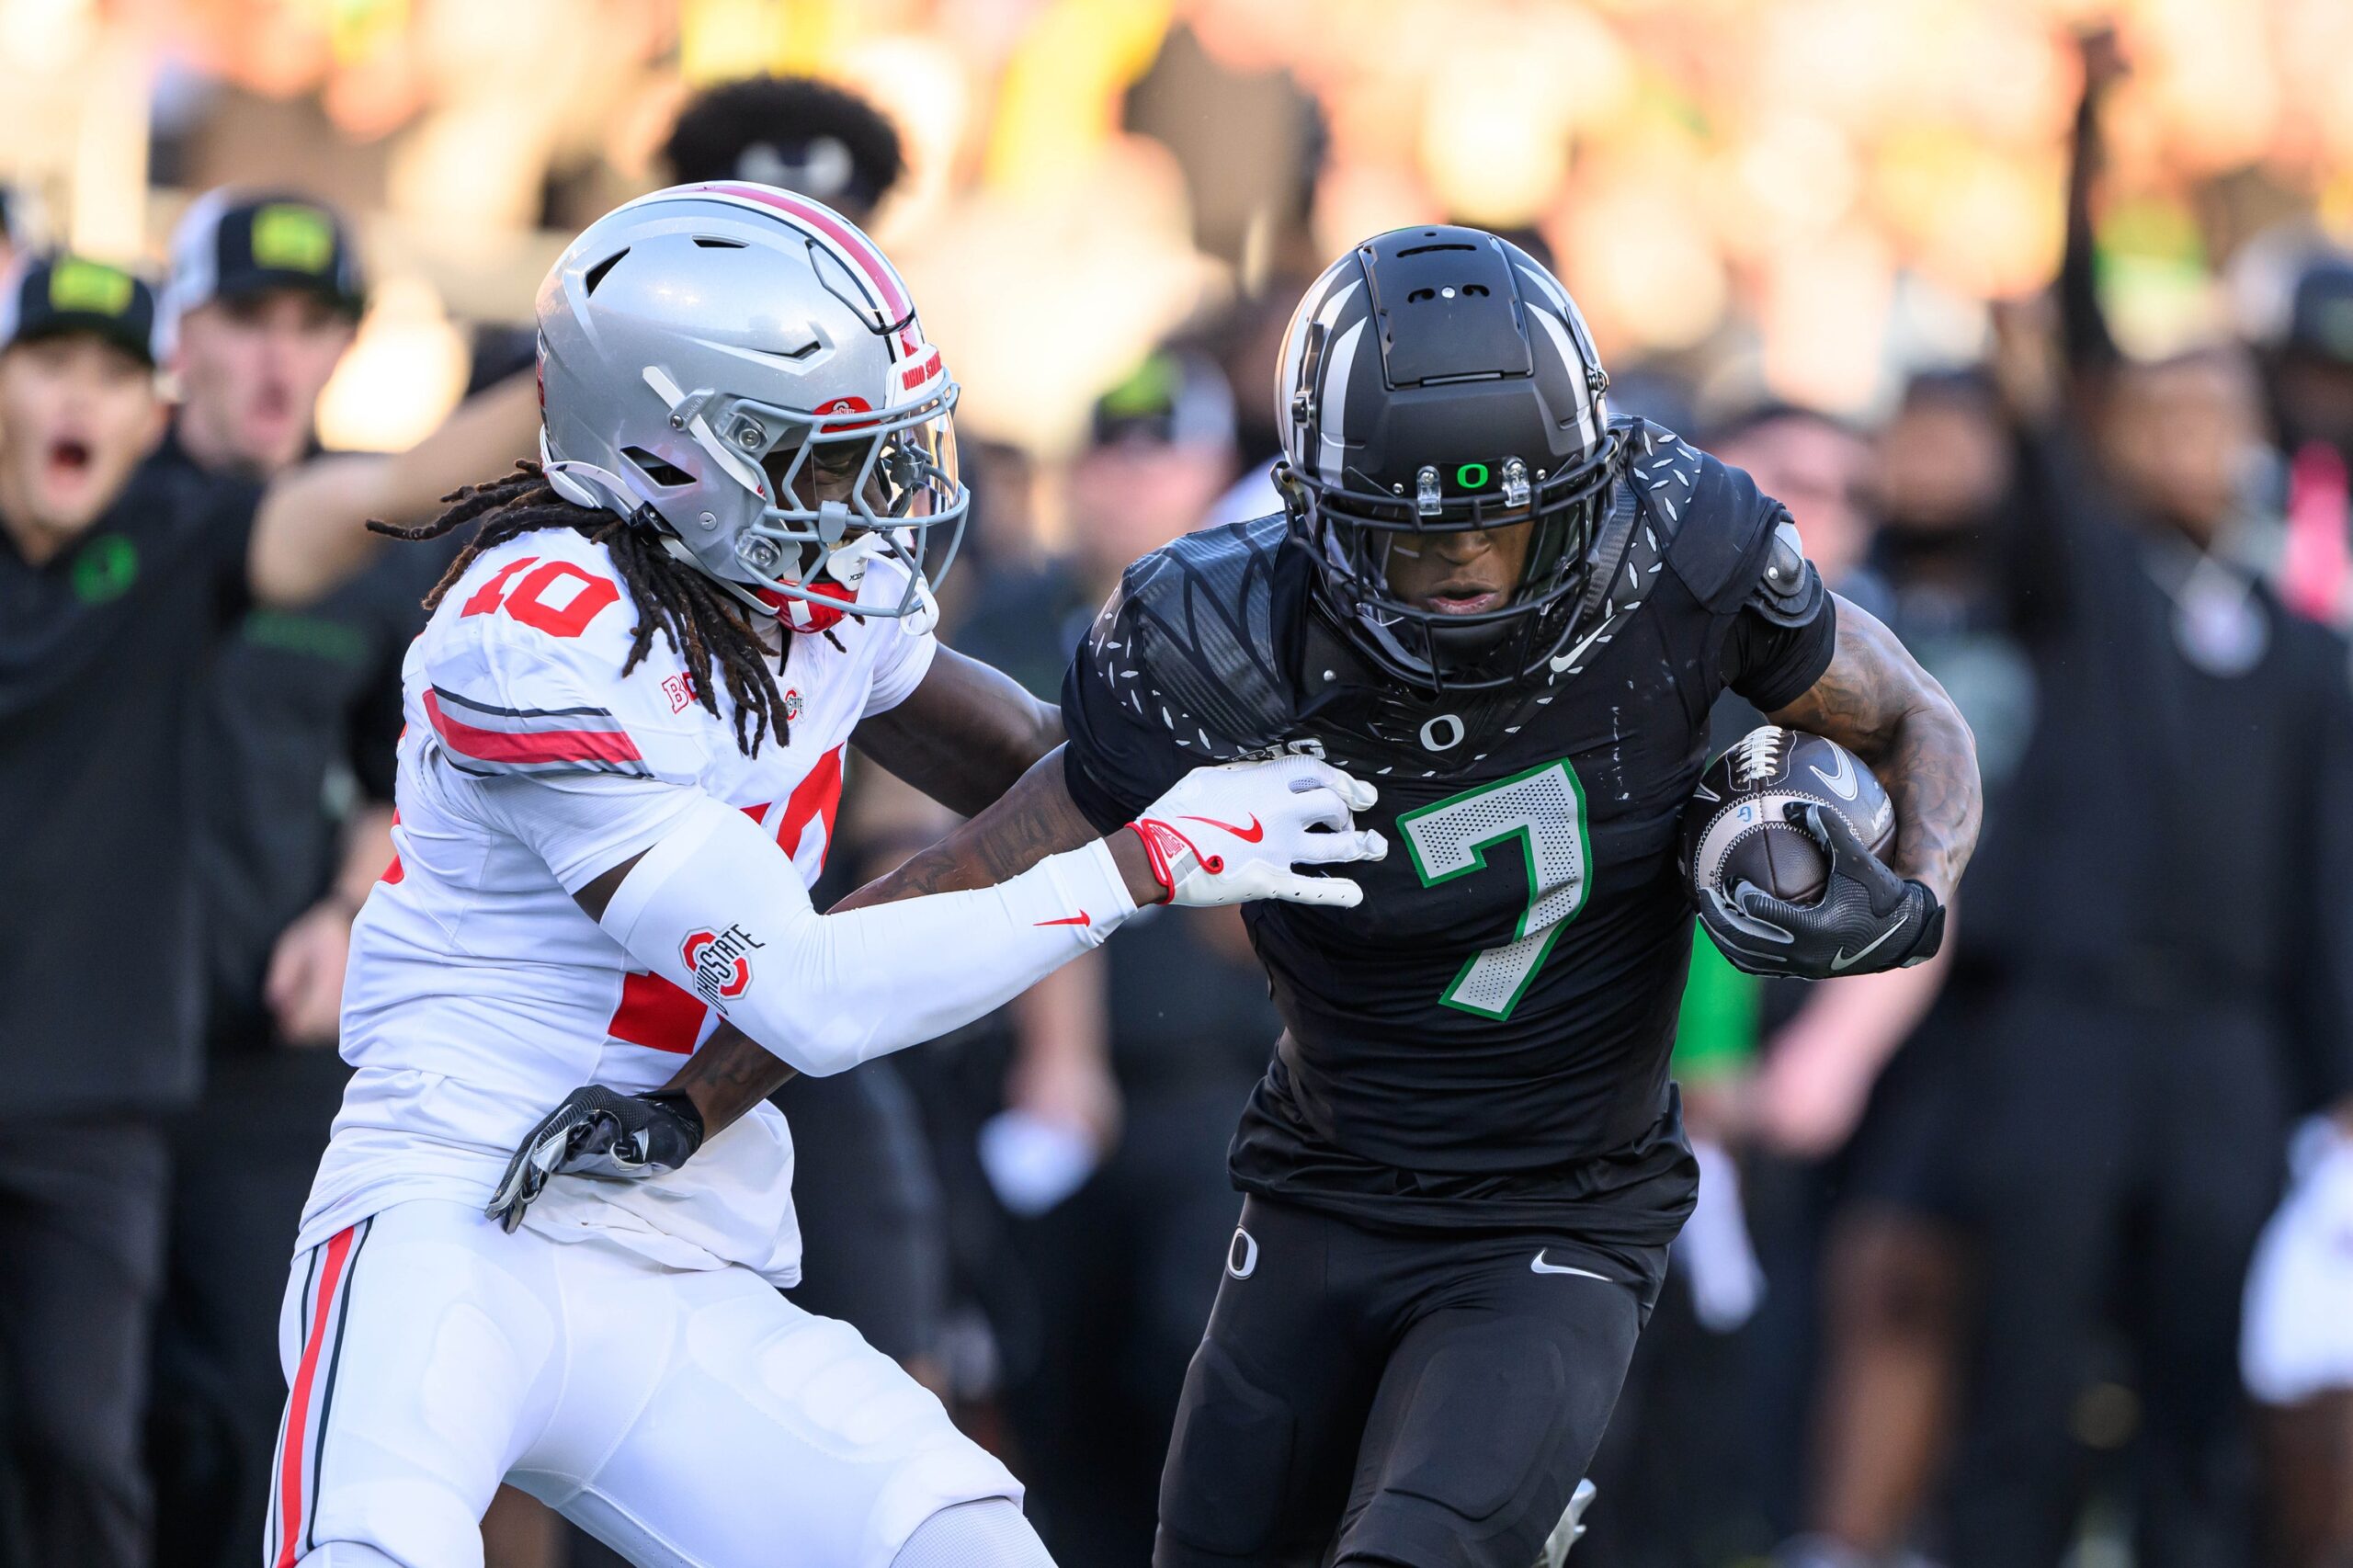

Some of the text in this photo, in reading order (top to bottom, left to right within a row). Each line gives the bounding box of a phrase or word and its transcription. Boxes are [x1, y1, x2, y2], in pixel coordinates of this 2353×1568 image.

[902, 364, 926, 391] OHIO
[1457, 463, 1488, 488] O
[460, 556, 620, 638] 10
[1420, 714, 1464, 751] O
[1396, 756, 1593, 1022] 7
[699, 924, 766, 979] STATE
